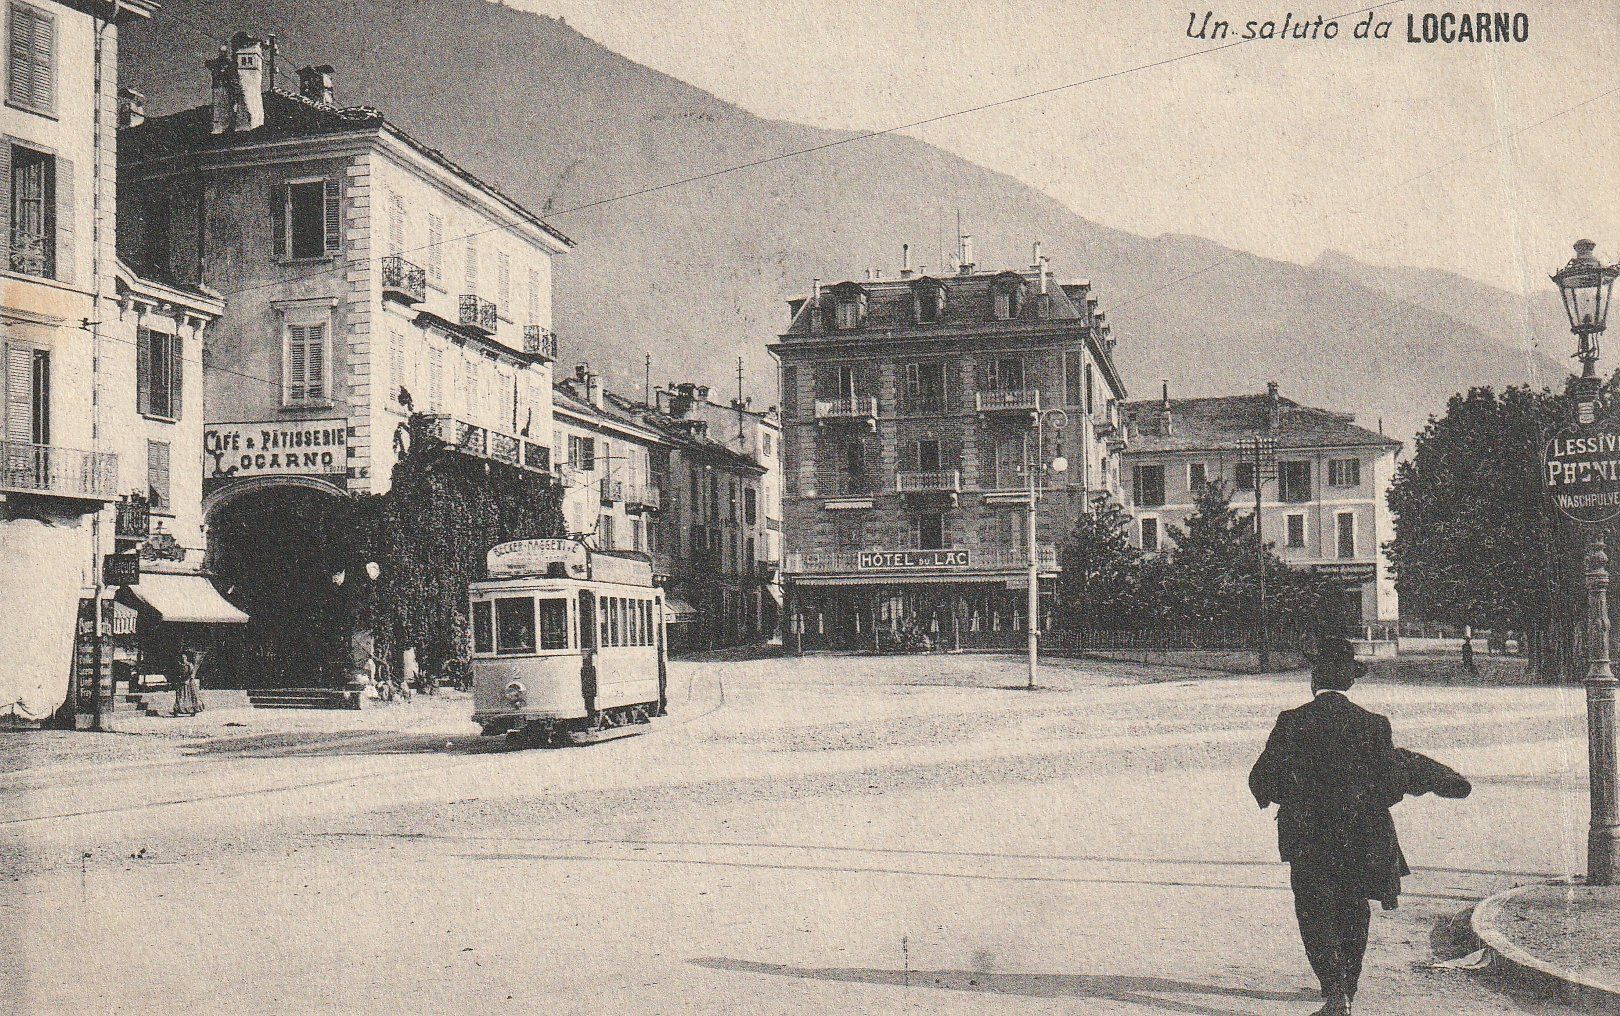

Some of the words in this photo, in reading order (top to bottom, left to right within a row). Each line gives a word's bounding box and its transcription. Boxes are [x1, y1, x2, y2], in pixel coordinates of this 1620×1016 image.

[204, 430, 240, 455] CAFÉ
[246, 437, 255, 450] &
[211, 451, 333, 478] LOCARNO
[1547, 461, 1620, 486] PHENI
[862, 552, 914, 567] HÔTEL
[934, 551, 967, 565] LAC
